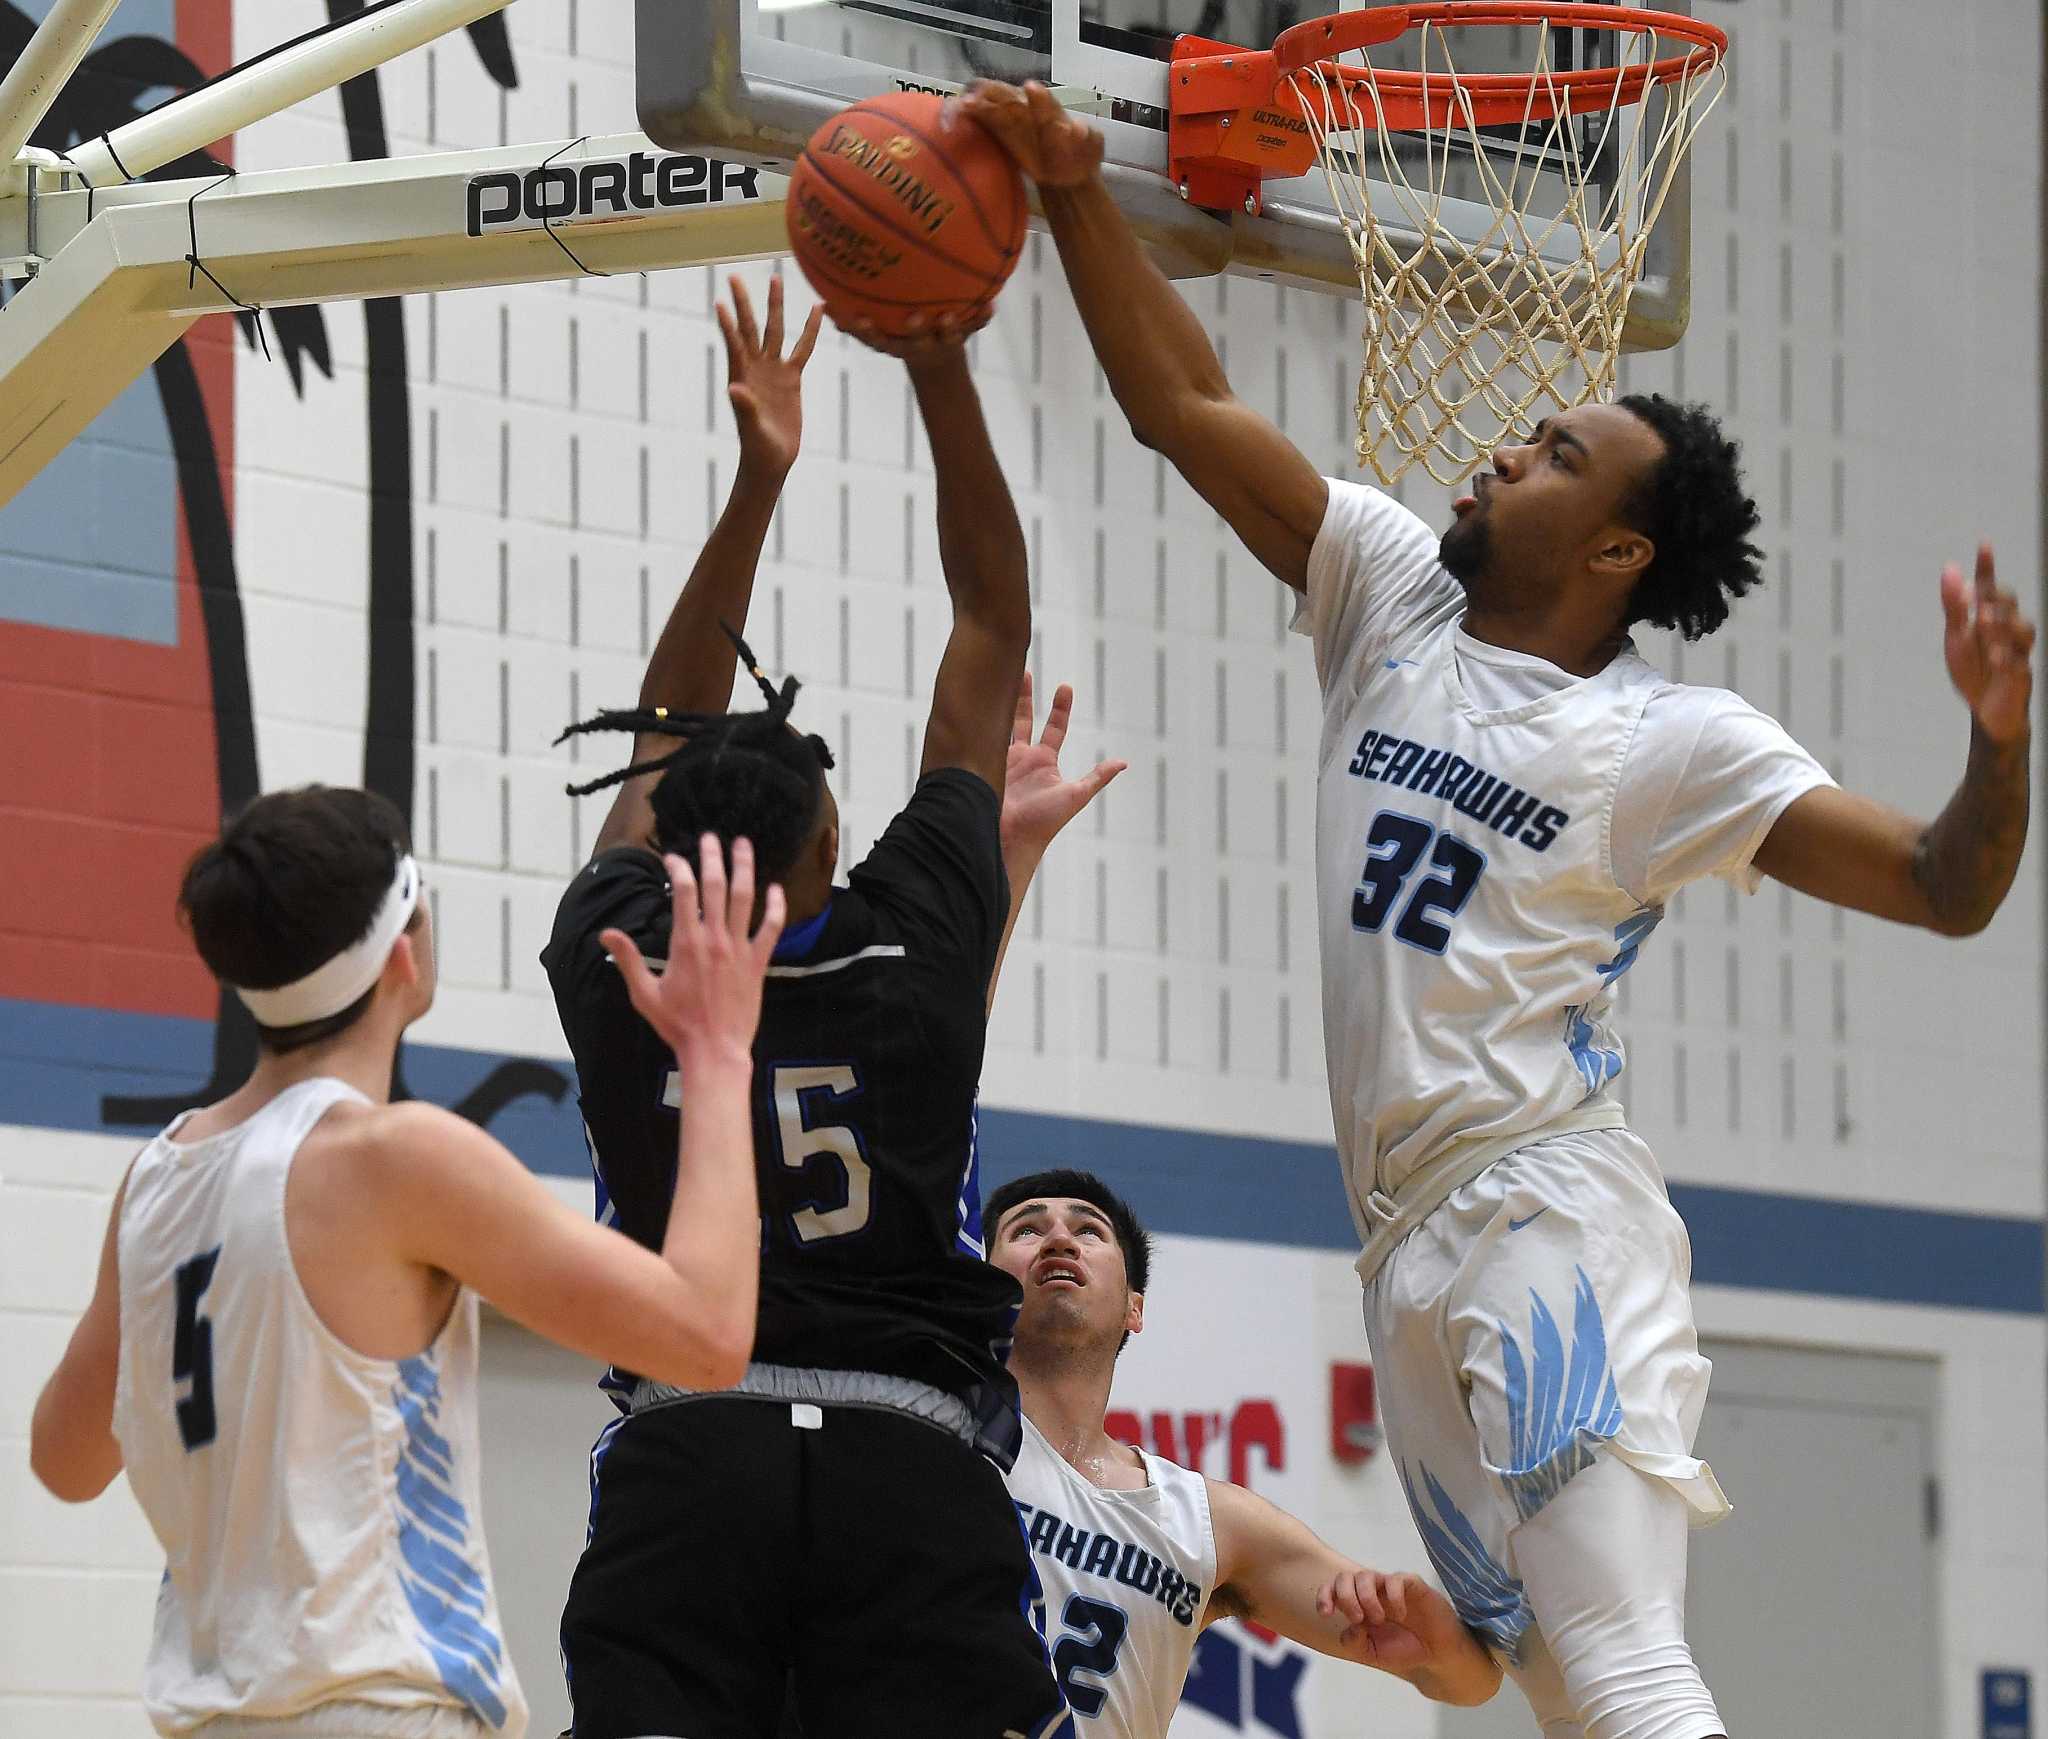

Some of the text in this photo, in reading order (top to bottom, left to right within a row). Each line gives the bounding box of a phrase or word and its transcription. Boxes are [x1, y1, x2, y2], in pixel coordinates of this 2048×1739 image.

[1349, 729, 1569, 853] SEAHAWKS
[1350, 808, 1488, 957] 32
[661, 1060, 874, 1247] 5
[1014, 1497, 1201, 1626] AHAWKS
